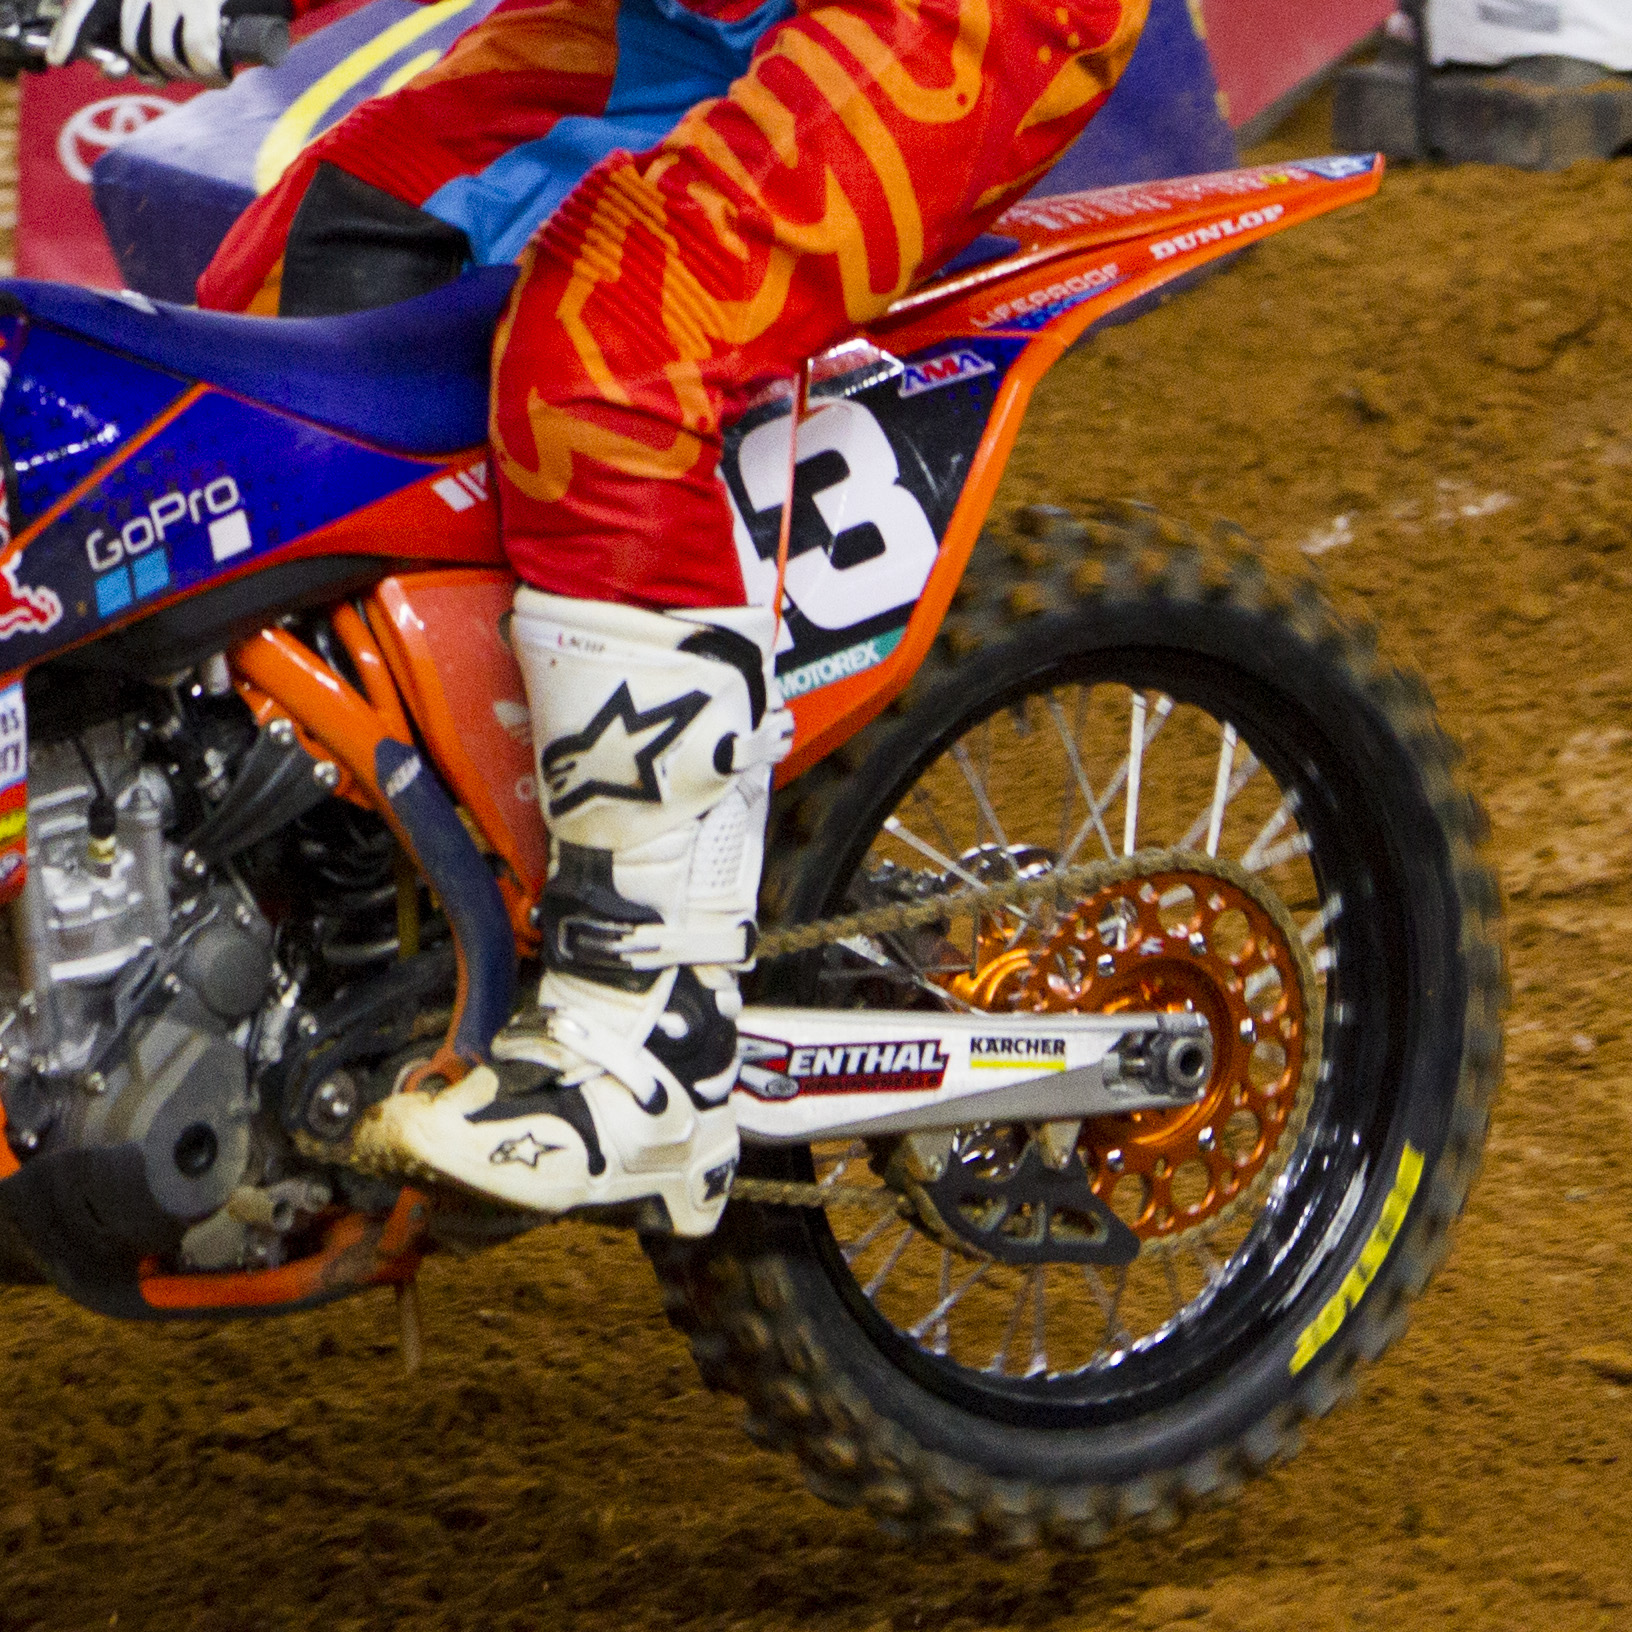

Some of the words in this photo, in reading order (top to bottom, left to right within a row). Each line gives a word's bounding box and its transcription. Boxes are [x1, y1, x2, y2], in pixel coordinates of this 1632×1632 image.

[1149, 204, 1285, 262] DUNLOP
[969, 262, 1120, 330] LIFEPROOF
[898, 350, 995, 397] AMA
[85, 476, 241, 573] GoPro
[728, 400, 944, 653] 3
